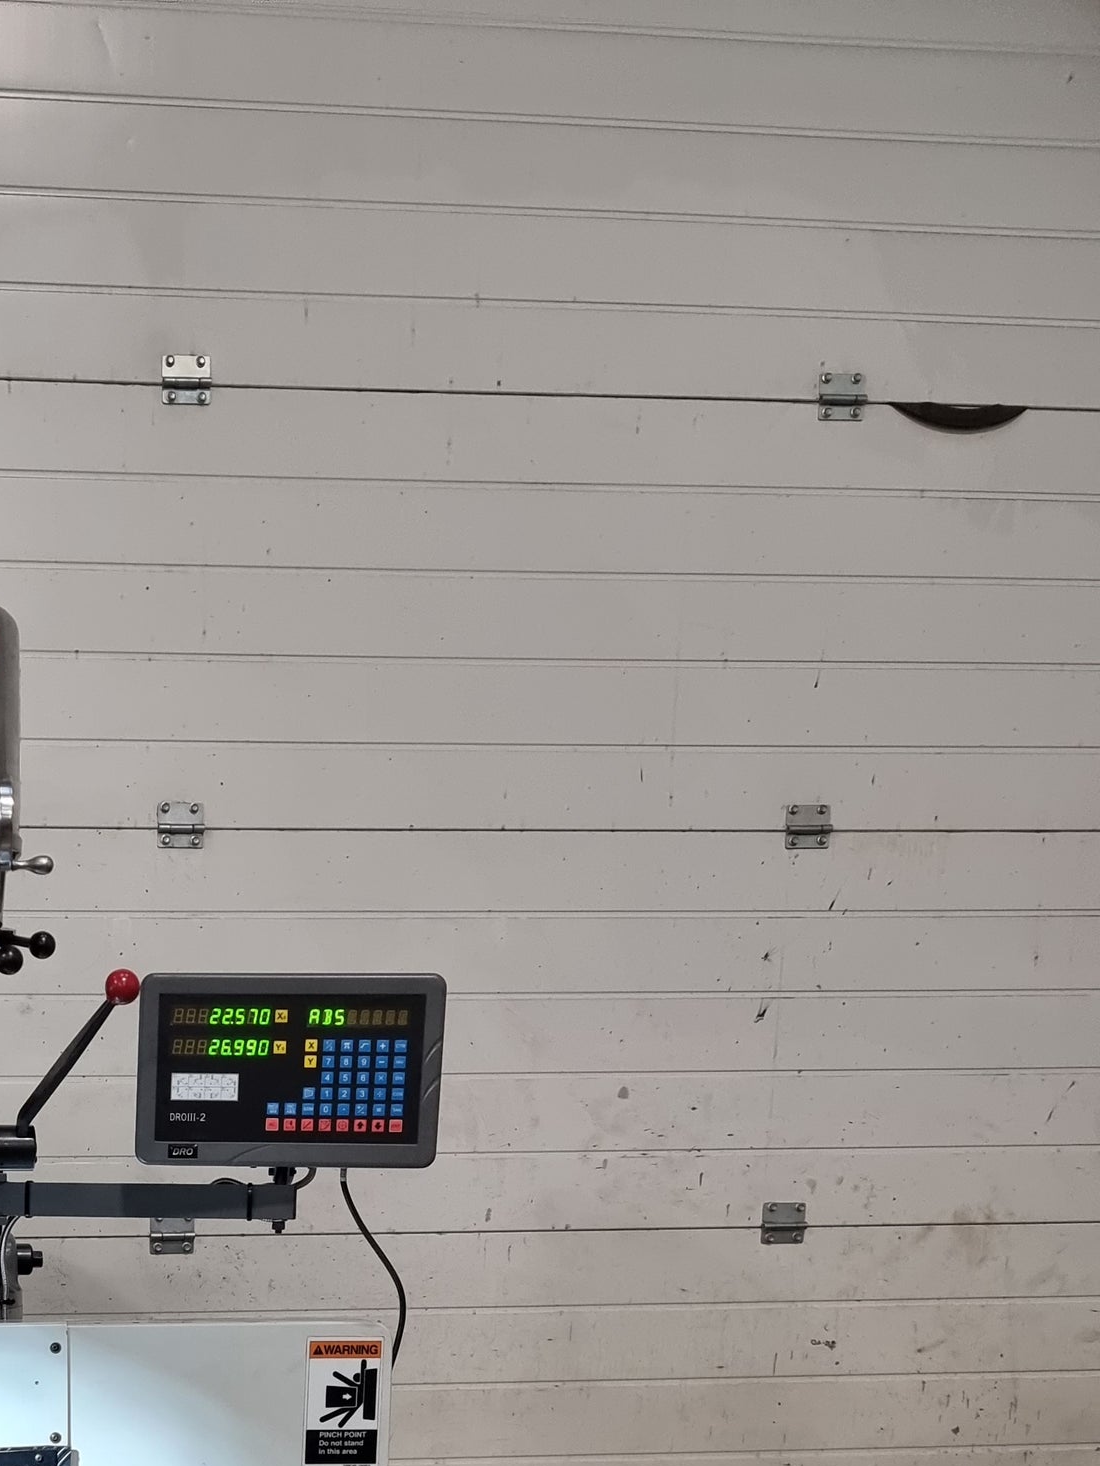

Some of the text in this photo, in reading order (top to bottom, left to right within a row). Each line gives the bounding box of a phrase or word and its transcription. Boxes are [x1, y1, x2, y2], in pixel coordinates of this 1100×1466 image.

[210, 1008, 270, 1025] 22.570
[309, 1009, 345, 1025] ABS
[208, 1039, 269, 1055] 26.990
[169, 1113, 206, 1122] DROIII-2
[172, 1148, 194, 1156] DRO
[324, 1345, 378, 1355] WARNING
